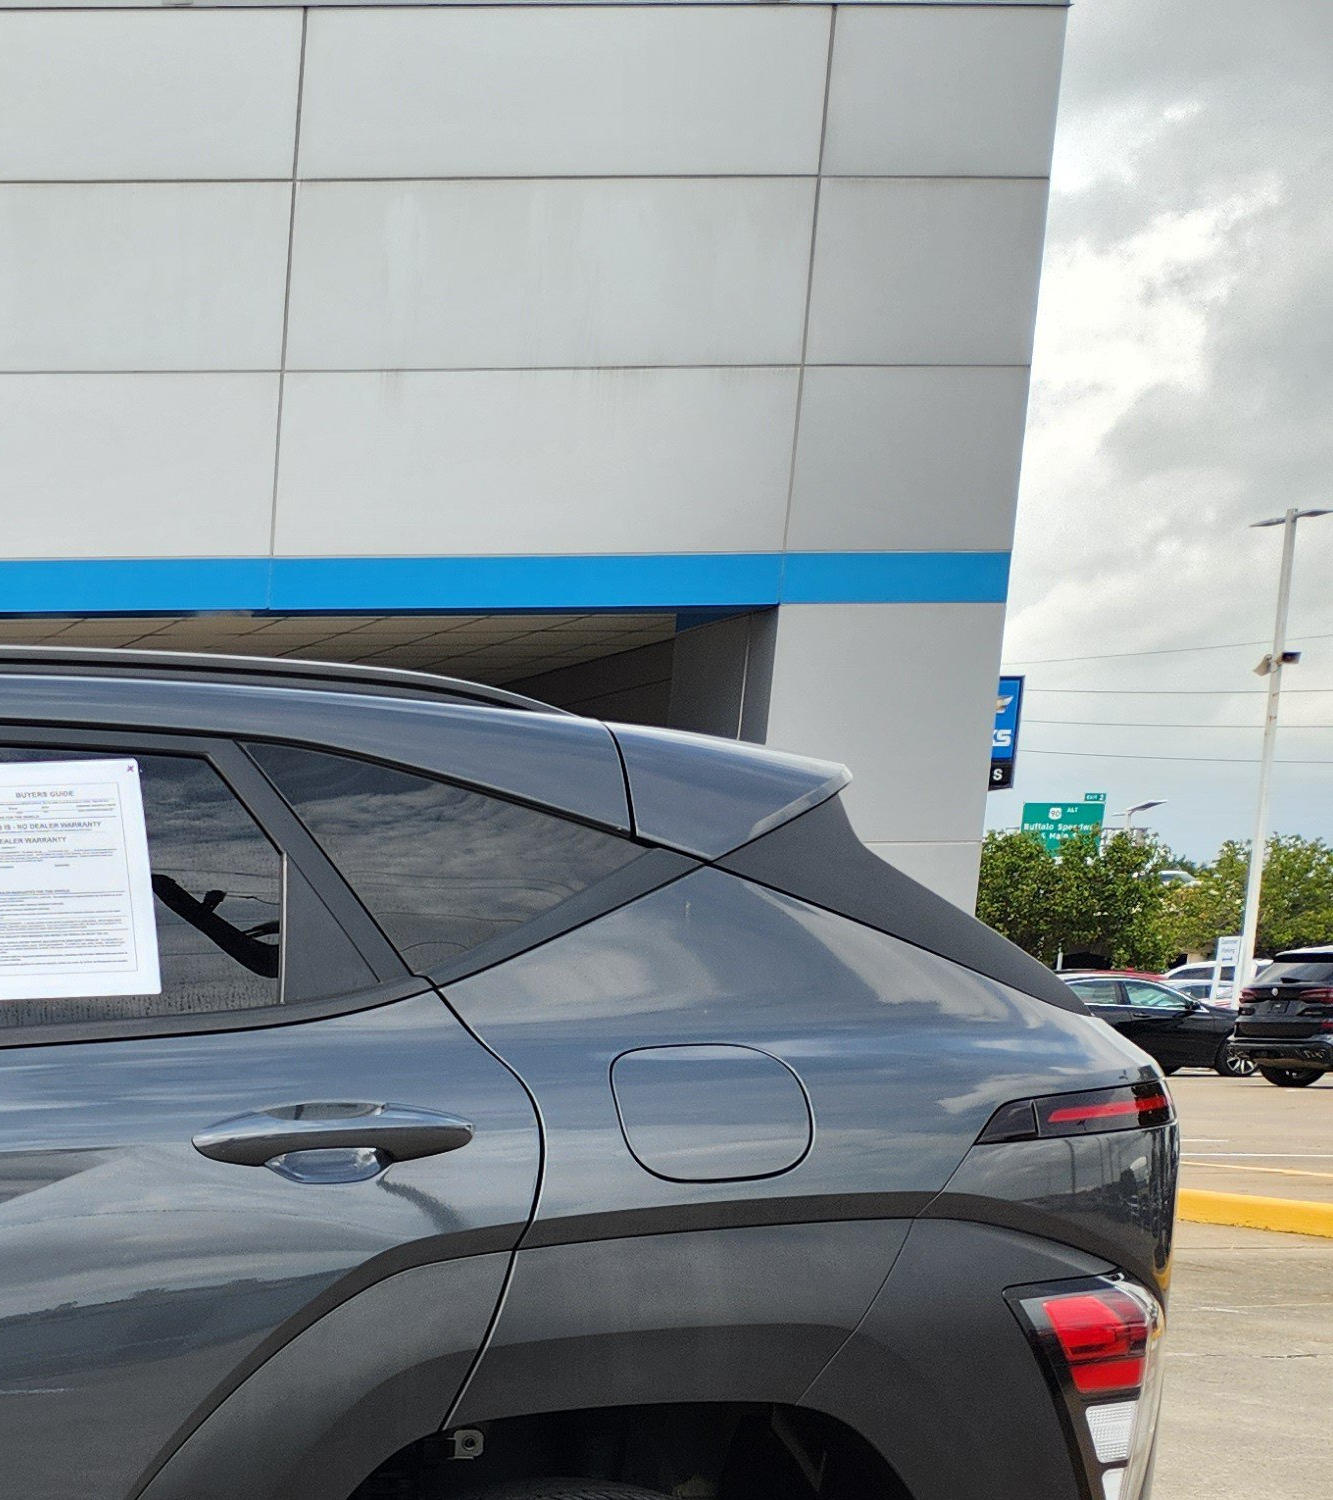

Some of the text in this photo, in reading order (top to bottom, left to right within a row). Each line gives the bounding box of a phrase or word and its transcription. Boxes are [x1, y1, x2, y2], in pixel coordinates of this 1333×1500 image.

[15, 790, 74, 799] BUYERS GUIDE
[4, 823, 11, 831] IS
[30, 822, 59, 830] DEALER
[60, 821, 102, 829] WARRANTY
[1023, 822, 1054, 831] Buffalo
[25, 836, 67, 844] WARRANTY
[1049, 832, 1069, 840] Main
